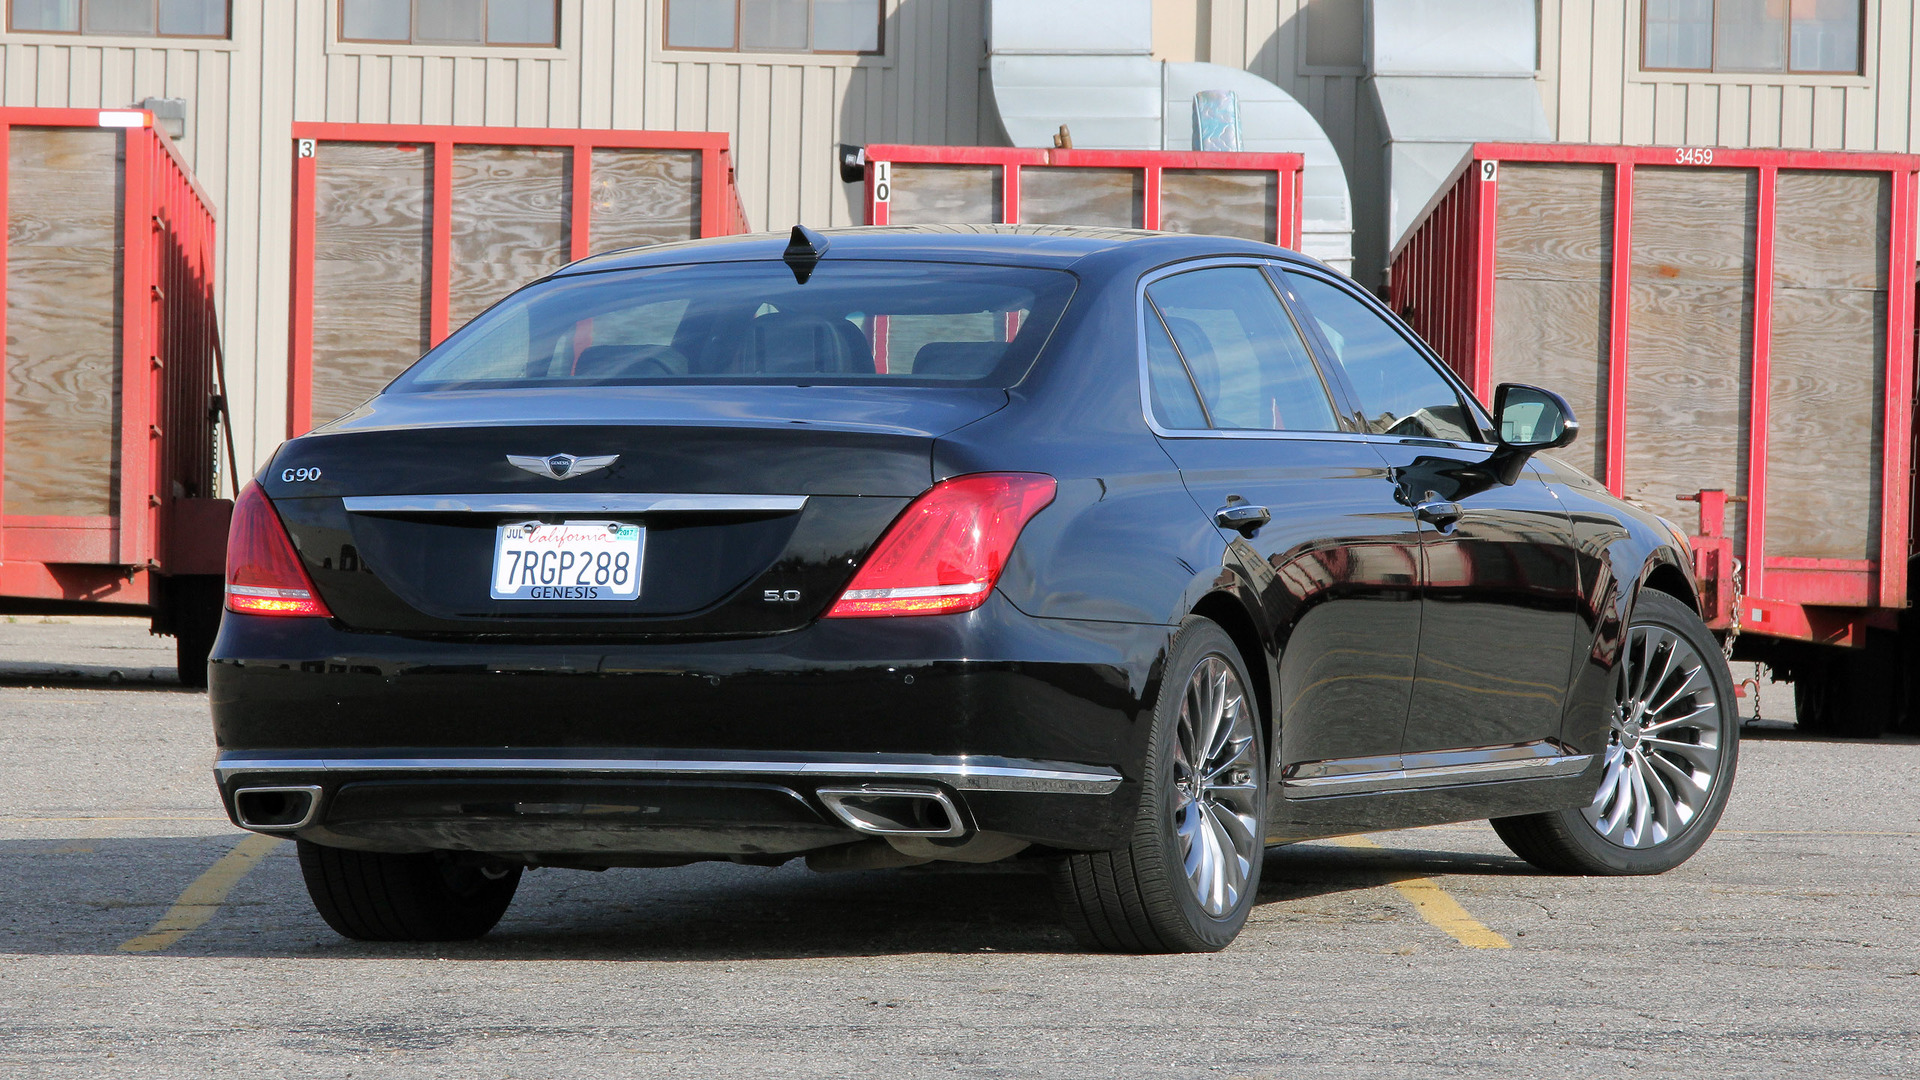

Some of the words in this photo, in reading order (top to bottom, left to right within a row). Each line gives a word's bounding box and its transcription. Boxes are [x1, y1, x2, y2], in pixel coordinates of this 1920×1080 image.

[301, 140, 313, 158] 3
[1675, 147, 1713, 165] 3459
[1483, 162, 1495, 180] 9
[281, 466, 322, 482] G90
[506, 528, 524, 539] JUL
[528, 525, 617, 548] California
[506, 550, 630, 586] 7RGP288
[530, 586, 598, 599] GENESIS
[763, 589, 801, 602] 5.0
